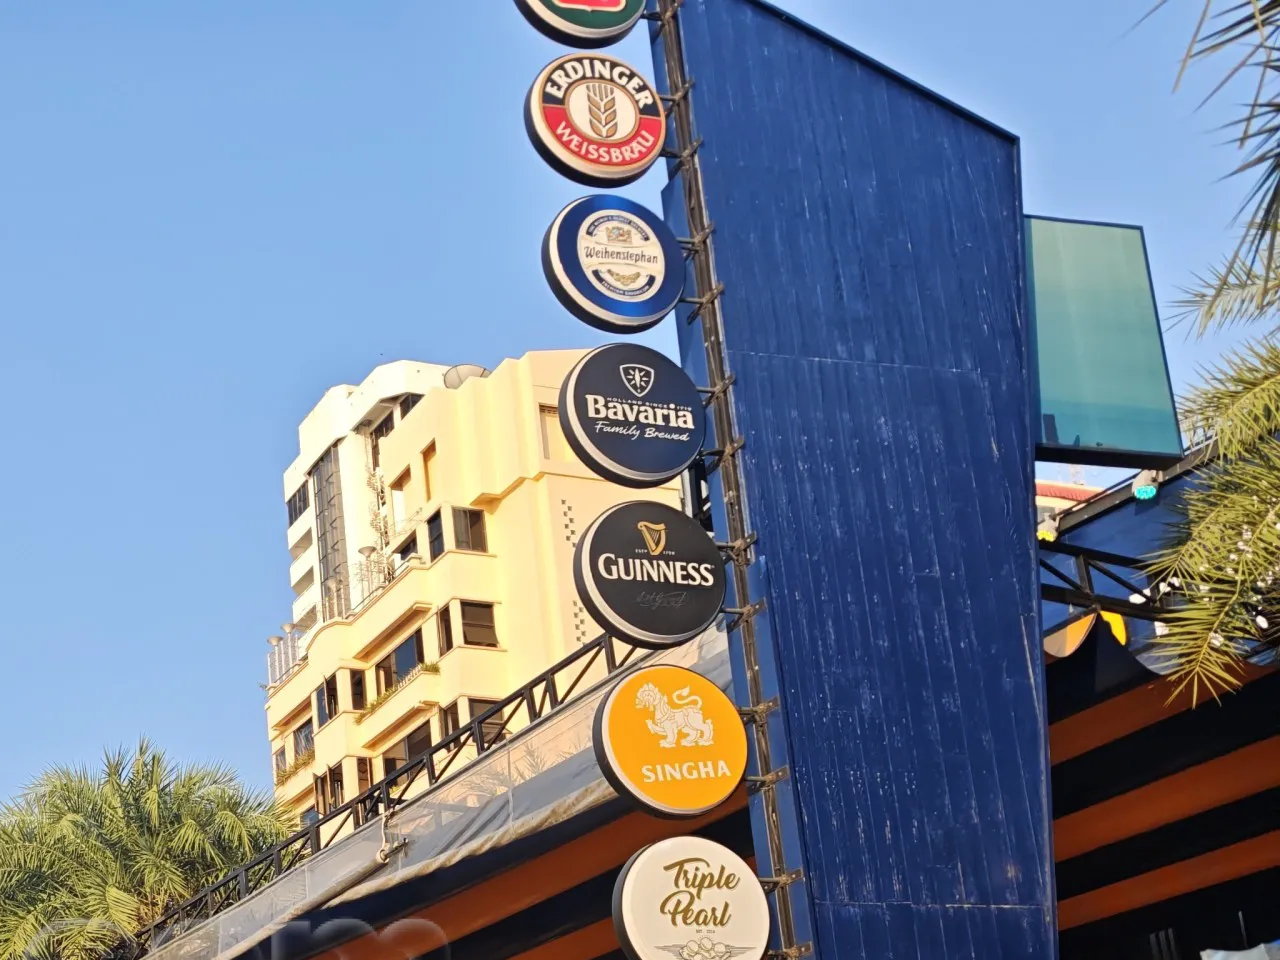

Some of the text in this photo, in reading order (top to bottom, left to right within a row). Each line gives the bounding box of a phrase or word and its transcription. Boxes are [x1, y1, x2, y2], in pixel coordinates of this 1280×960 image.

[545, 59, 654, 109] ERDINGER
[584, 246, 658, 264] Weihenstephan
[585, 394, 695, 429] Bavaria
[595, 420, 690, 441] Family Brewed
[598, 553, 714, 587] GUINNESS
[642, 760, 732, 783] SINGHA
[663, 857, 741, 899] Triple
[659, 890, 732, 927] Pearl
